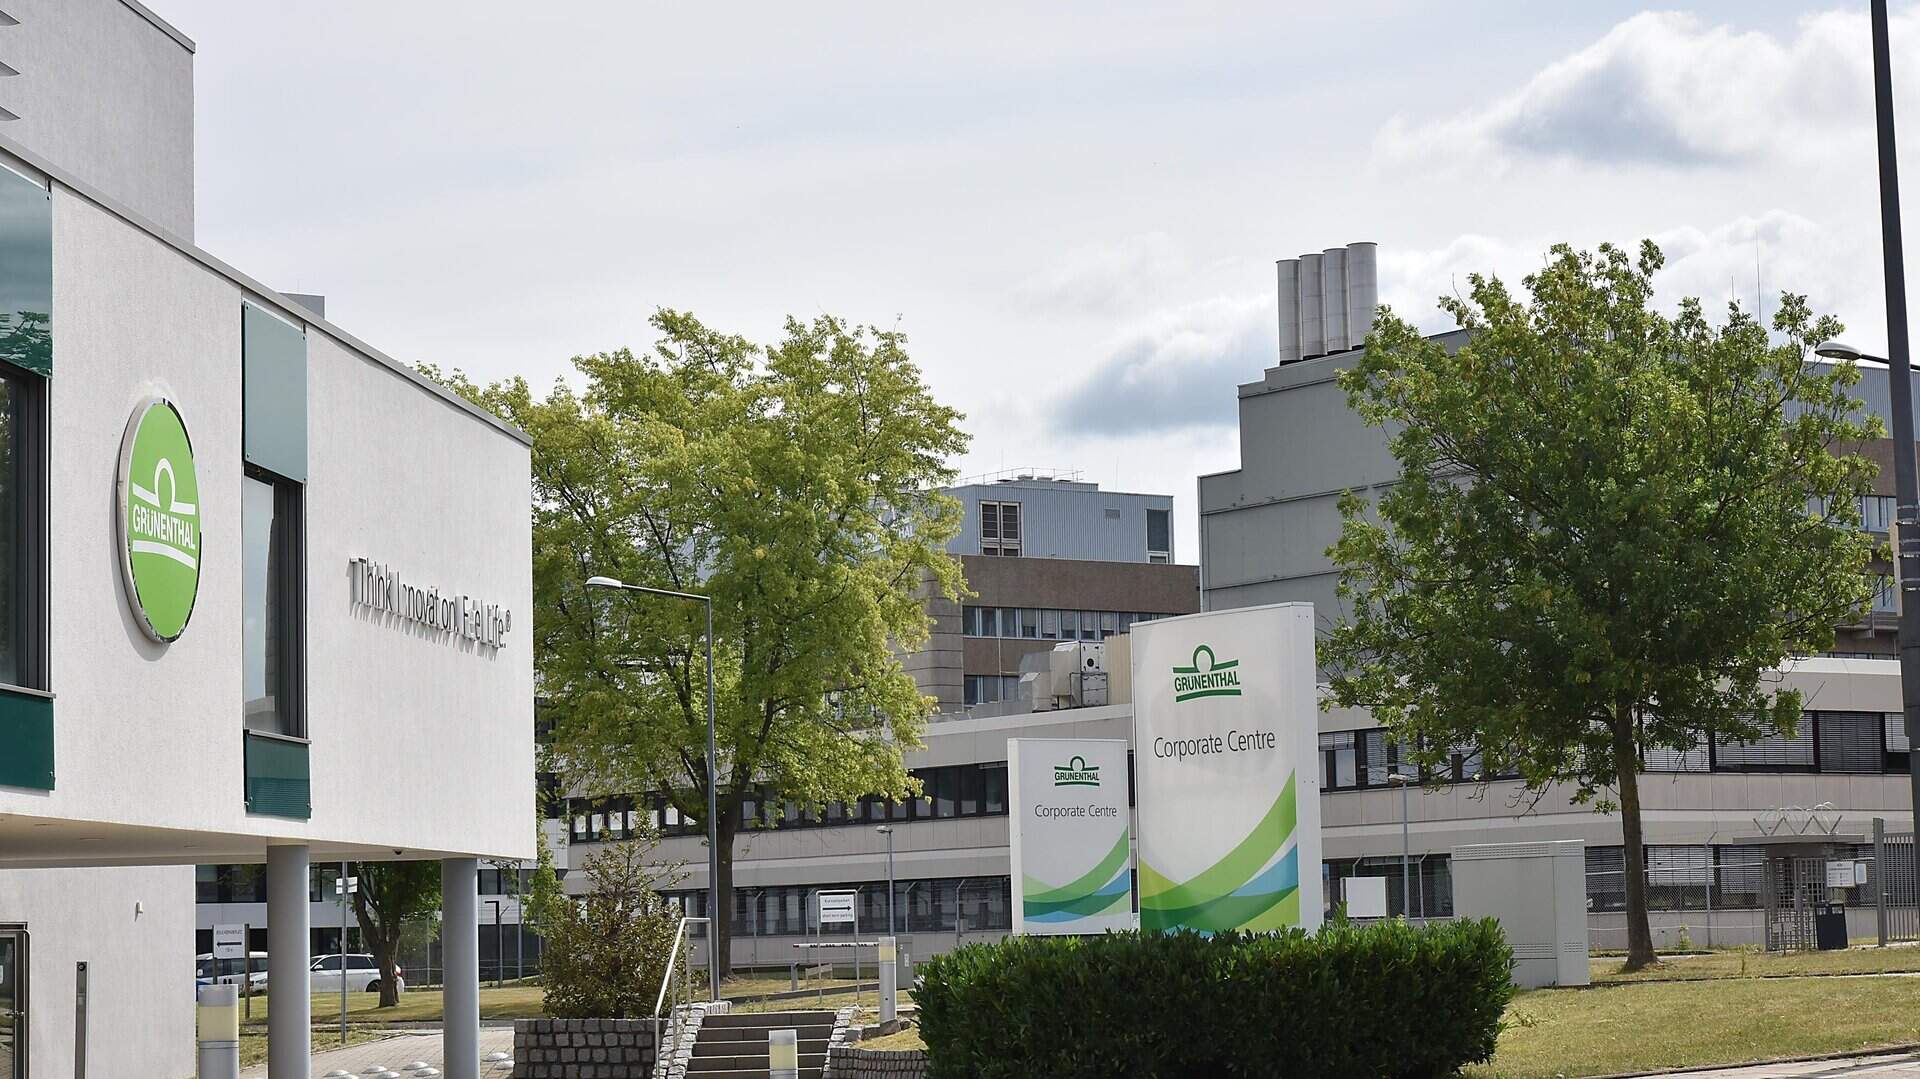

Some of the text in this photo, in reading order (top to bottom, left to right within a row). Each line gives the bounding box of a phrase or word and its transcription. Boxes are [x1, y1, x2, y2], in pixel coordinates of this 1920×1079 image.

[133, 503, 196, 551] GRÜNENTHAL
[351, 557, 393, 612] Think
[396, 571, 460, 633] Innovaton.
[463, 595, 483, 641] Fel
[1174, 671, 1241, 692] GRÜNENTHAL
[1154, 729, 1276, 762] Corporate Centre
[1034, 804, 1118, 820] Corporate Centre
